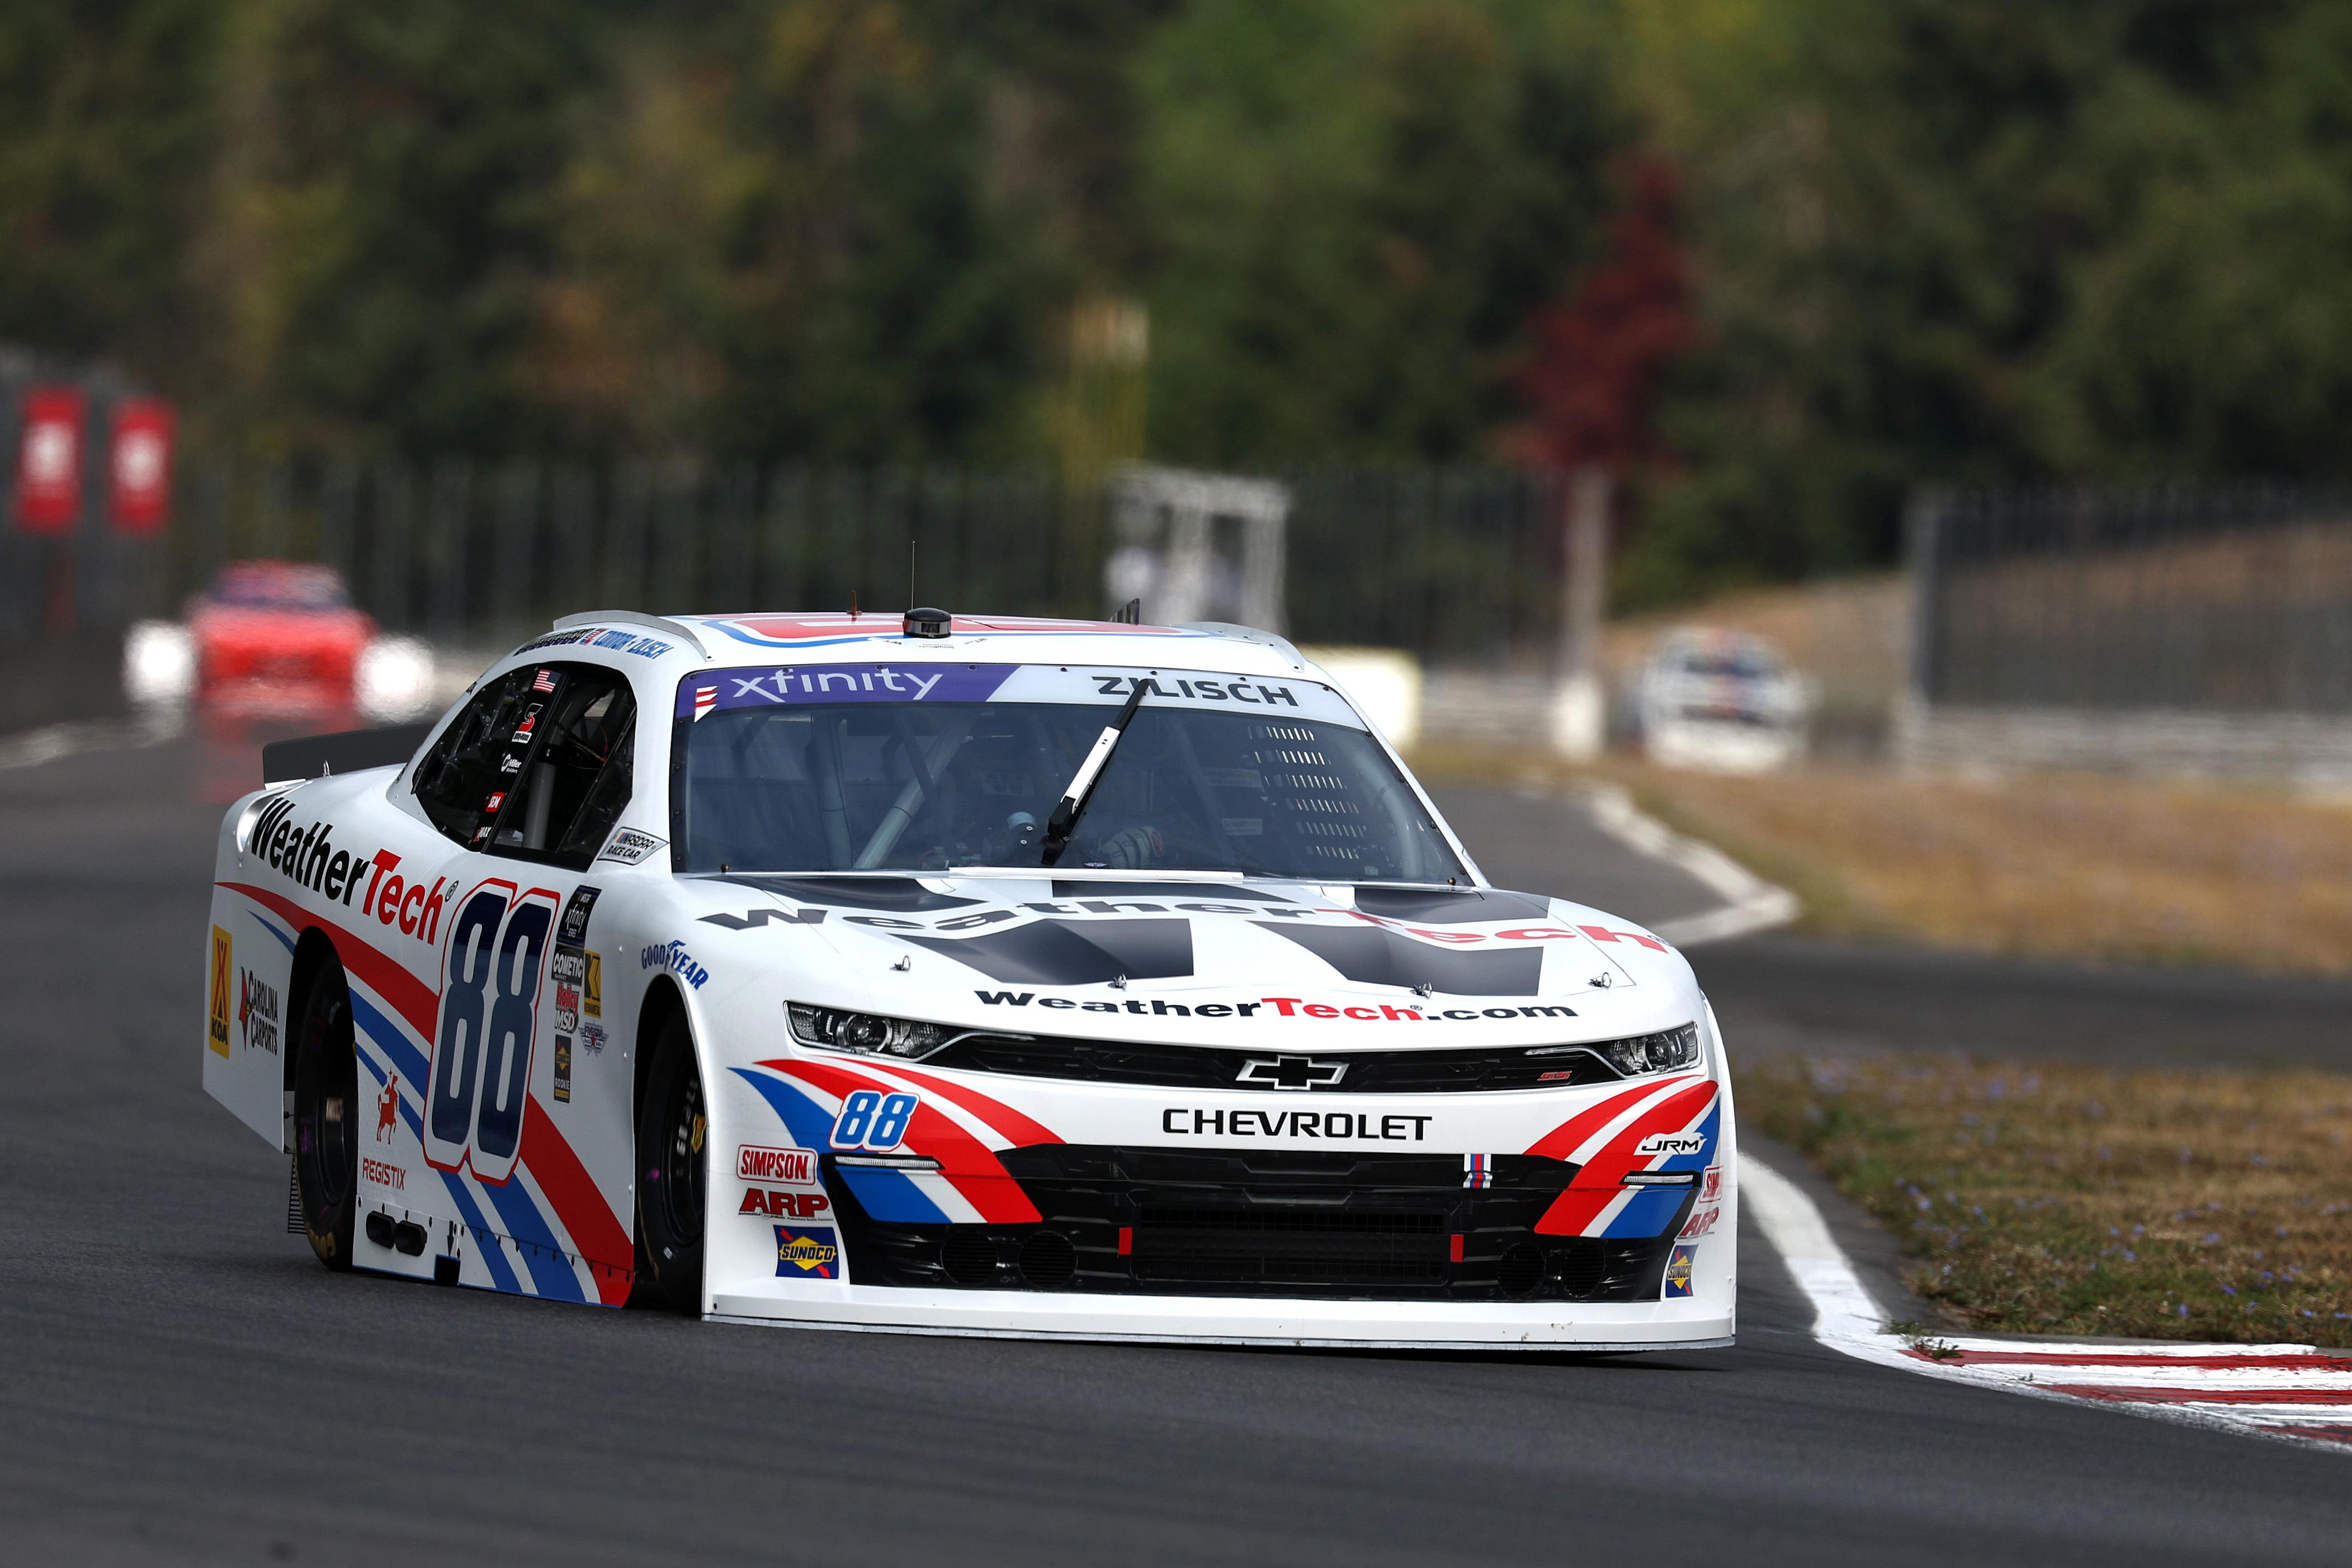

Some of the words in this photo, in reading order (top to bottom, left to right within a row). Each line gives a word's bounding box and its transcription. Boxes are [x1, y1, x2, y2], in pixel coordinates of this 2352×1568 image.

[731, 668, 943, 703] xfinity
[606, 845, 624, 856] RACE
[623, 848, 641, 859] CAR
[622, 833, 655, 850] NASCAR
[565, 904, 587, 933] xfinity
[553, 952, 583, 978] COMETIC
[641, 940, 709, 990] GOODYEAR
[249, 970, 278, 1024] CAROLINA
[211, 1017, 228, 1045] KOA
[251, 1012, 277, 1056] CARPORTS
[431, 889, 553, 1159] 88
[554, 1010, 578, 1033] MSD
[555, 1078, 569, 1089] ROOKIE
[1537, 1071, 1572, 1081] SS
[835, 1092, 918, 1146] 88
[1163, 1109, 1432, 1141] CHEVROLET
[1642, 1140, 1699, 1155] JRM
[362, 1157, 406, 1191] REGISTIX
[742, 1150, 809, 1180] SIMPSON
[739, 1188, 829, 1217] ARP
[781, 1245, 834, 1260] SUNOCO
